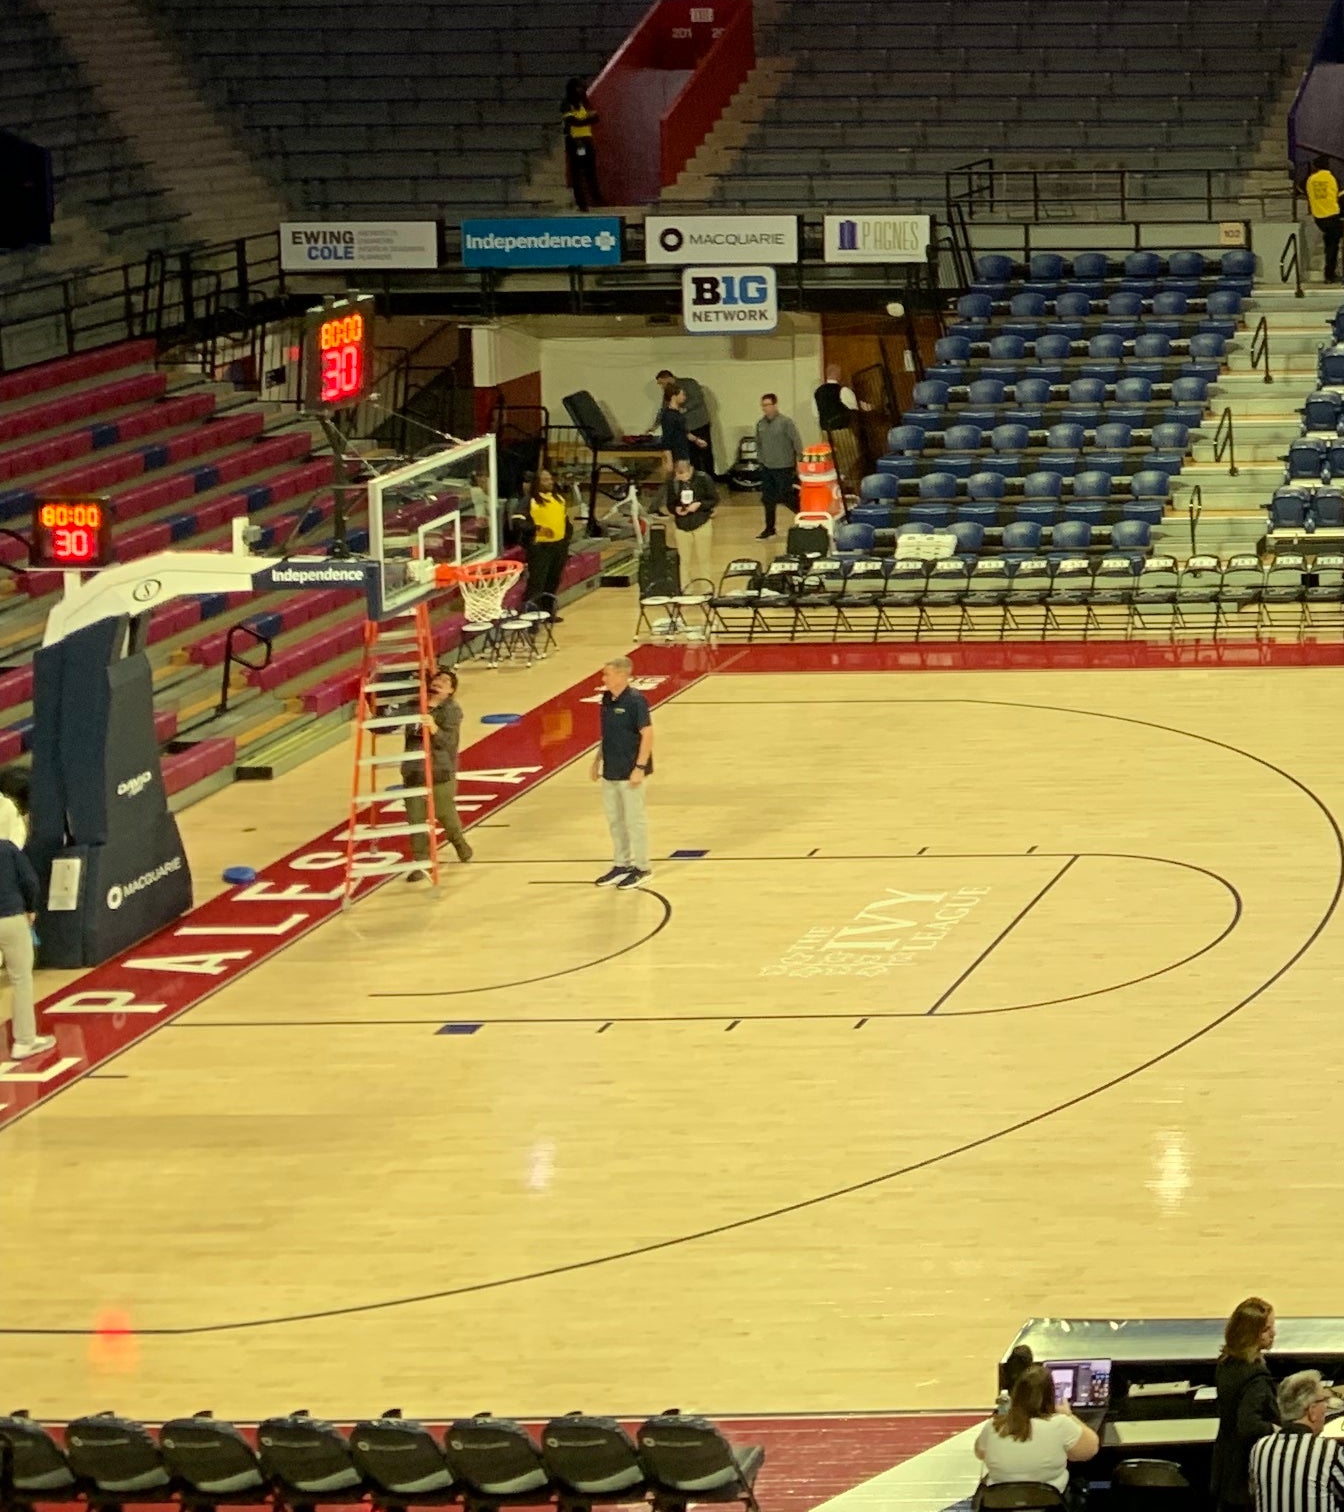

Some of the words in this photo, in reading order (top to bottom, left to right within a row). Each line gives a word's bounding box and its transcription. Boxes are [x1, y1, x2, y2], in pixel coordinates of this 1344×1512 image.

[292, 231, 354, 244] EWING
[465, 233, 592, 252] Independence
[690, 233, 784, 246] MACQUARIE
[308, 246, 354, 260] COLE
[692, 310, 768, 323] NETWORK
[322, 348, 359, 402] 30
[42, 506, 98, 527] 80:00
[54, 529, 88, 557] 30
[272, 569, 364, 584] Independence
[124, 856, 182, 897] MACQUARIE
[820, 888, 948, 952] IVY
[902, 885, 993, 951] LEAGUE
